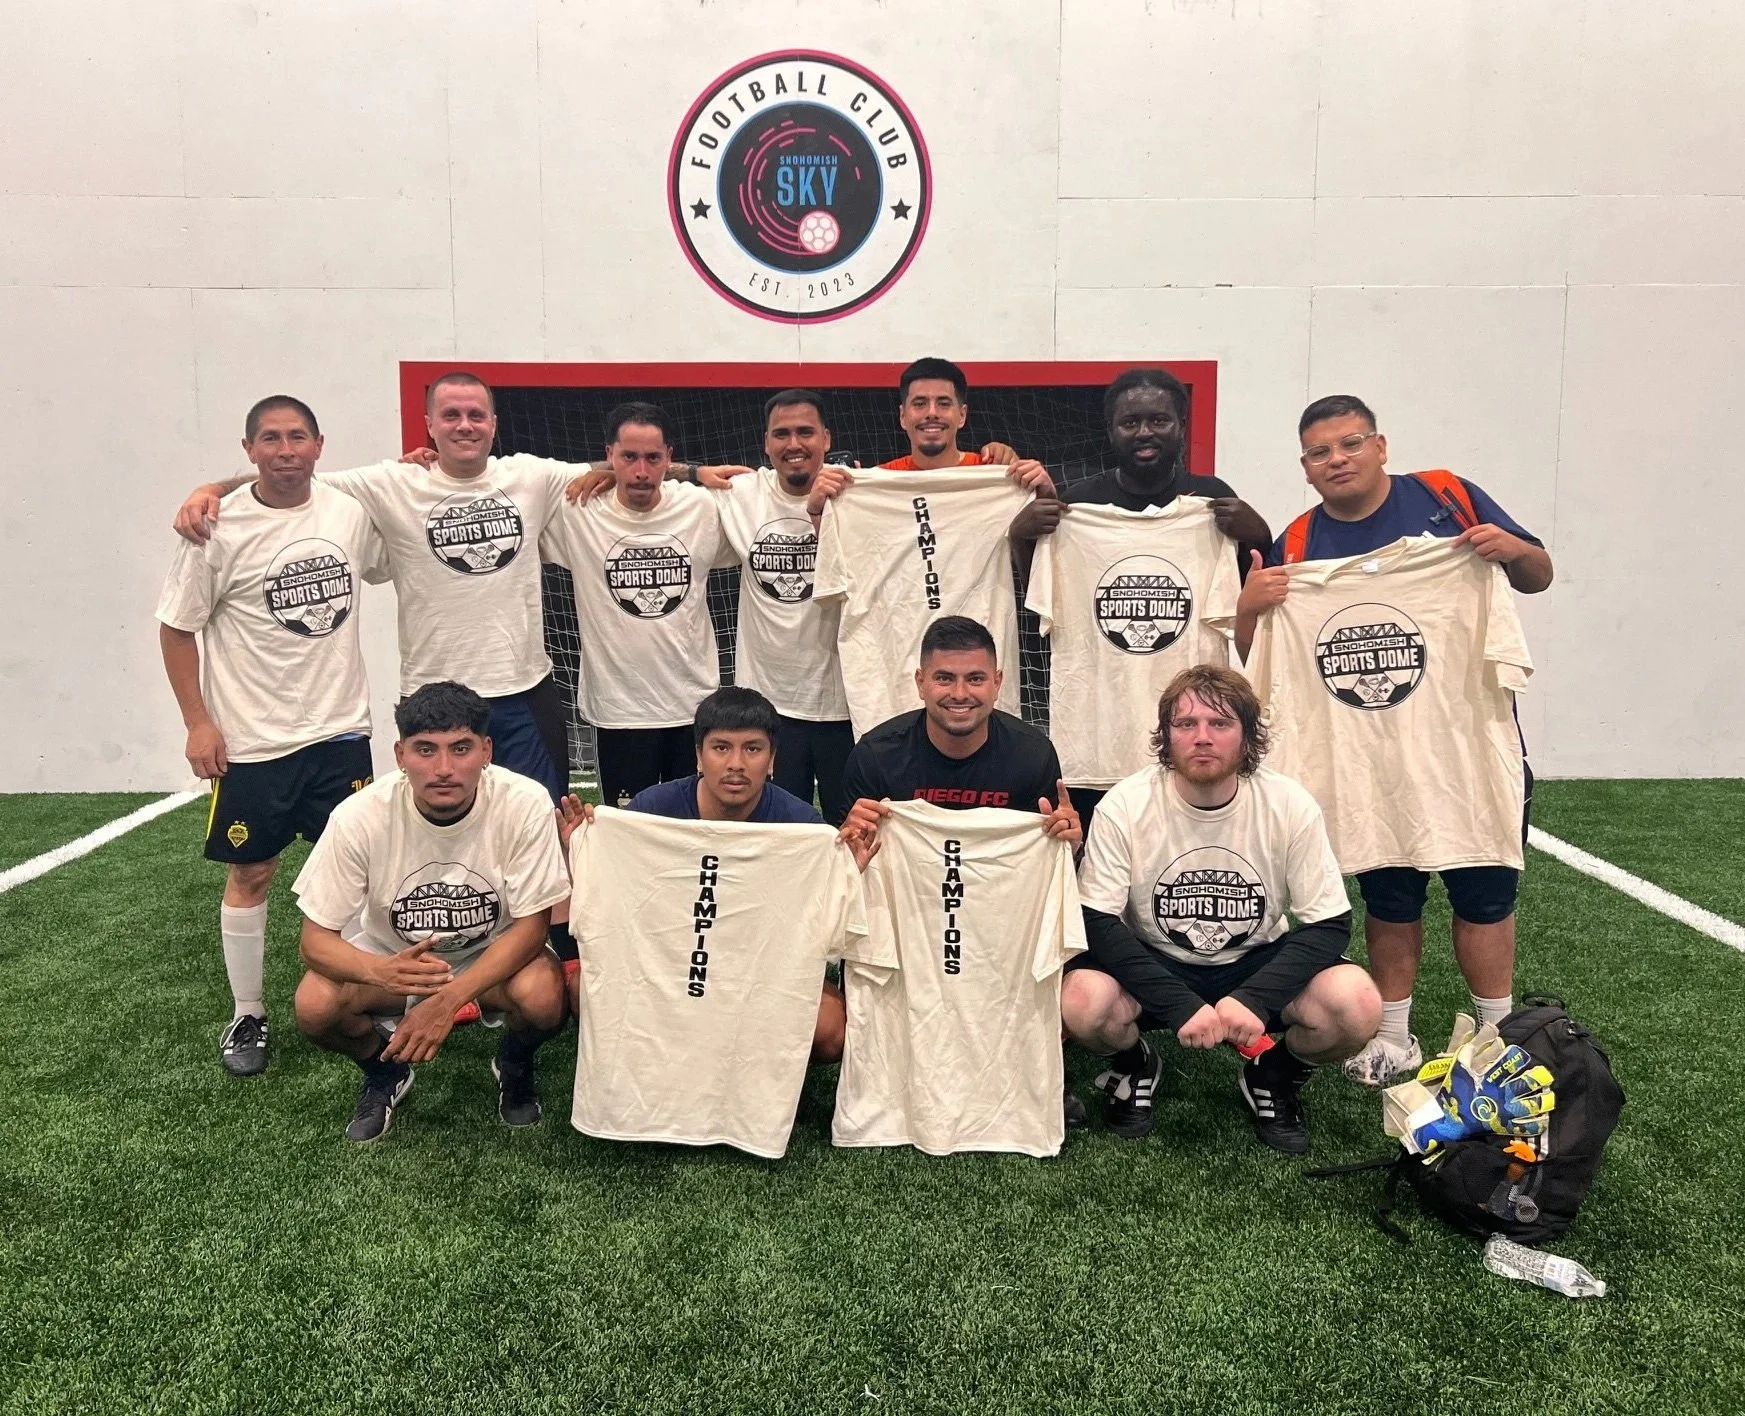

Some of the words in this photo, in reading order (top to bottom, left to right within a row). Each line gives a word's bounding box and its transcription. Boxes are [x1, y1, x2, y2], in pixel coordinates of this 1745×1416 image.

[691, 71, 827, 170] FOOTBALL
[850, 92, 907, 169] CLUB
[780, 155, 837, 165] SNOHOMISH
[777, 166, 837, 206] SKY
[749, 272, 789, 298] EST.
[808, 272, 854, 299] 2023
[433, 523, 482, 545] SPORTS
[483, 517, 519, 538] DOME
[763, 545, 817, 553] SNOHOMISH
[912, 497, 941, 610] CHAMPIONS
[620, 559, 679, 569] SNOHOMISH
[752, 554, 793, 570] SPORTS
[283, 568, 341, 587] SNOHOMISH
[610, 570, 653, 587] SPORTS
[656, 567, 688, 585] DOME
[271, 583, 320, 608] SPORTS
[321, 576, 350, 599] DOME
[1112, 590, 1176, 598] SNOHOMISH
[1100, 600, 1146, 617] SPORTS
[1149, 600, 1186, 618] DOME
[1334, 637, 1405, 652] SNOHOMISH
[1323, 651, 1376, 675] SPORTS
[1378, 647, 1419, 669] DOME
[980, 790, 1009, 806] FC
[1175, 886, 1247, 897] SNOHOMISH
[410, 898, 480, 908] SNOHOMISH
[942, 839, 964, 975] CHAMPIONS
[1159, 897, 1213, 917] SPORTS
[1217, 898, 1259, 918] DOME
[396, 909, 449, 930] SPORTS
[452, 904, 494, 928] DOME
[687, 855, 719, 998] CHAMPIONS
